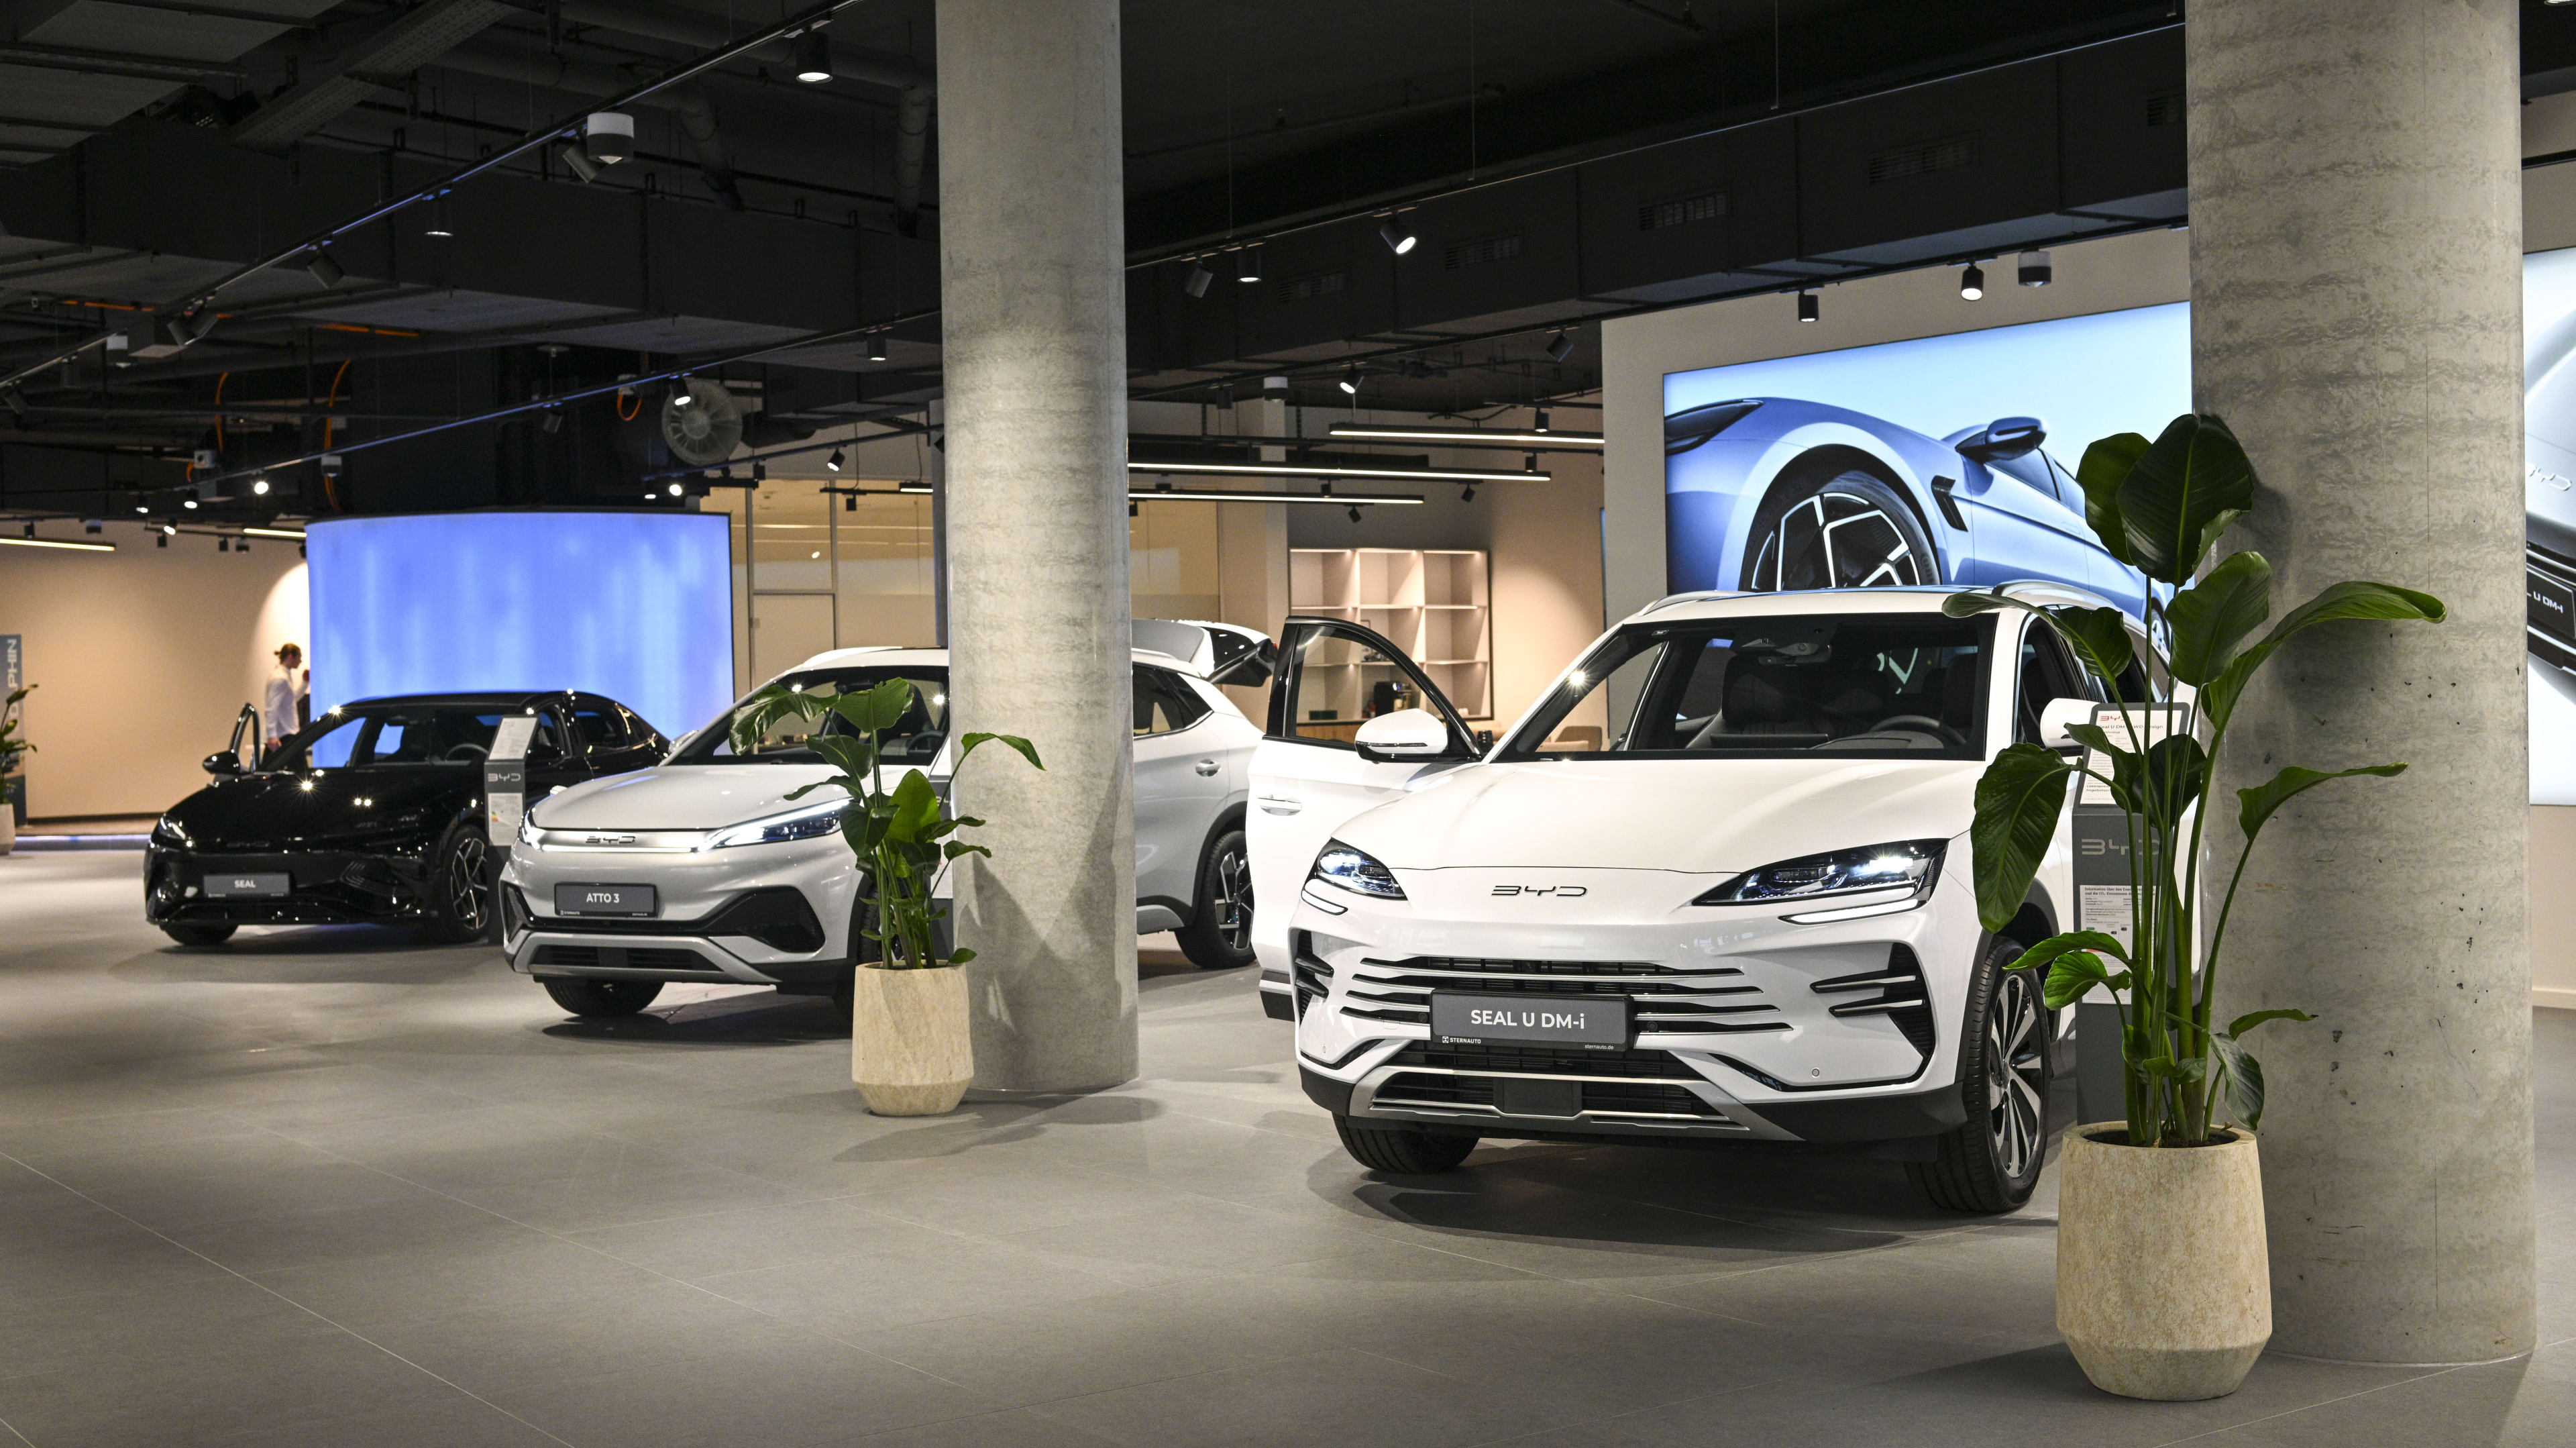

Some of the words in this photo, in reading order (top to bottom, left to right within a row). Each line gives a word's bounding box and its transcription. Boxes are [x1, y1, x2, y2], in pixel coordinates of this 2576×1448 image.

[2533, 590, 2541, 601] U
[488, 773, 521, 782] BYD
[586, 835, 636, 843] BYD
[235, 880, 256, 888] SEAL
[1491, 885, 1588, 896] BYD
[586, 893, 612, 903] ATTO
[613, 893, 620, 903] 3
[1470, 1009, 1517, 1027] SEAL
[1522, 1012, 1535, 1027] U
[1542, 1013, 1585, 1029] DM-i
